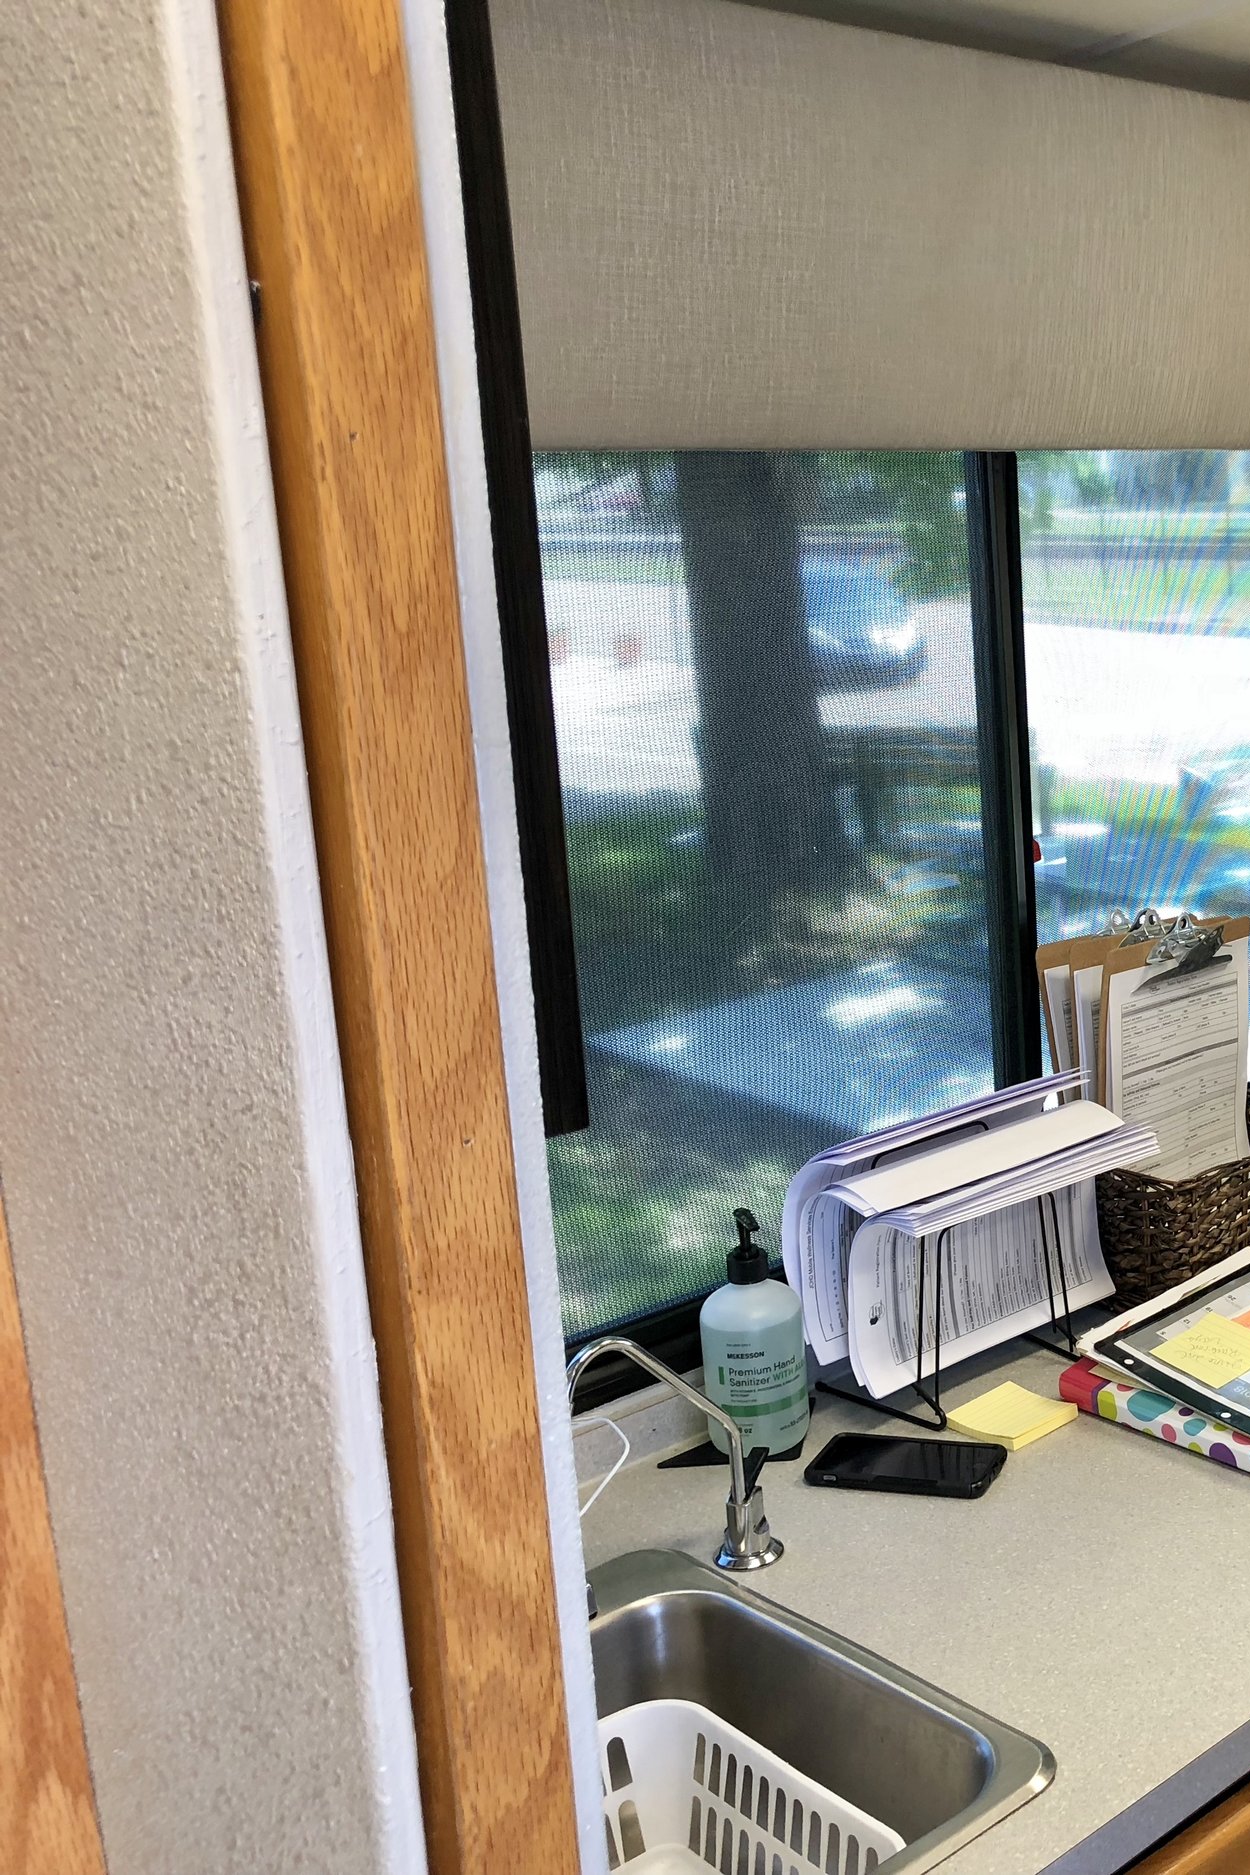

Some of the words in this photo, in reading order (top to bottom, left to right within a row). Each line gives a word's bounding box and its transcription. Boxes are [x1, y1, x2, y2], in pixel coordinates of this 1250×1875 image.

[729, 1366, 772, 1376] Premium
[773, 1354, 795, 1371] Hand
[729, 1377, 770, 1387] Sanitizer
[772, 1366, 794, 1380] WITH
